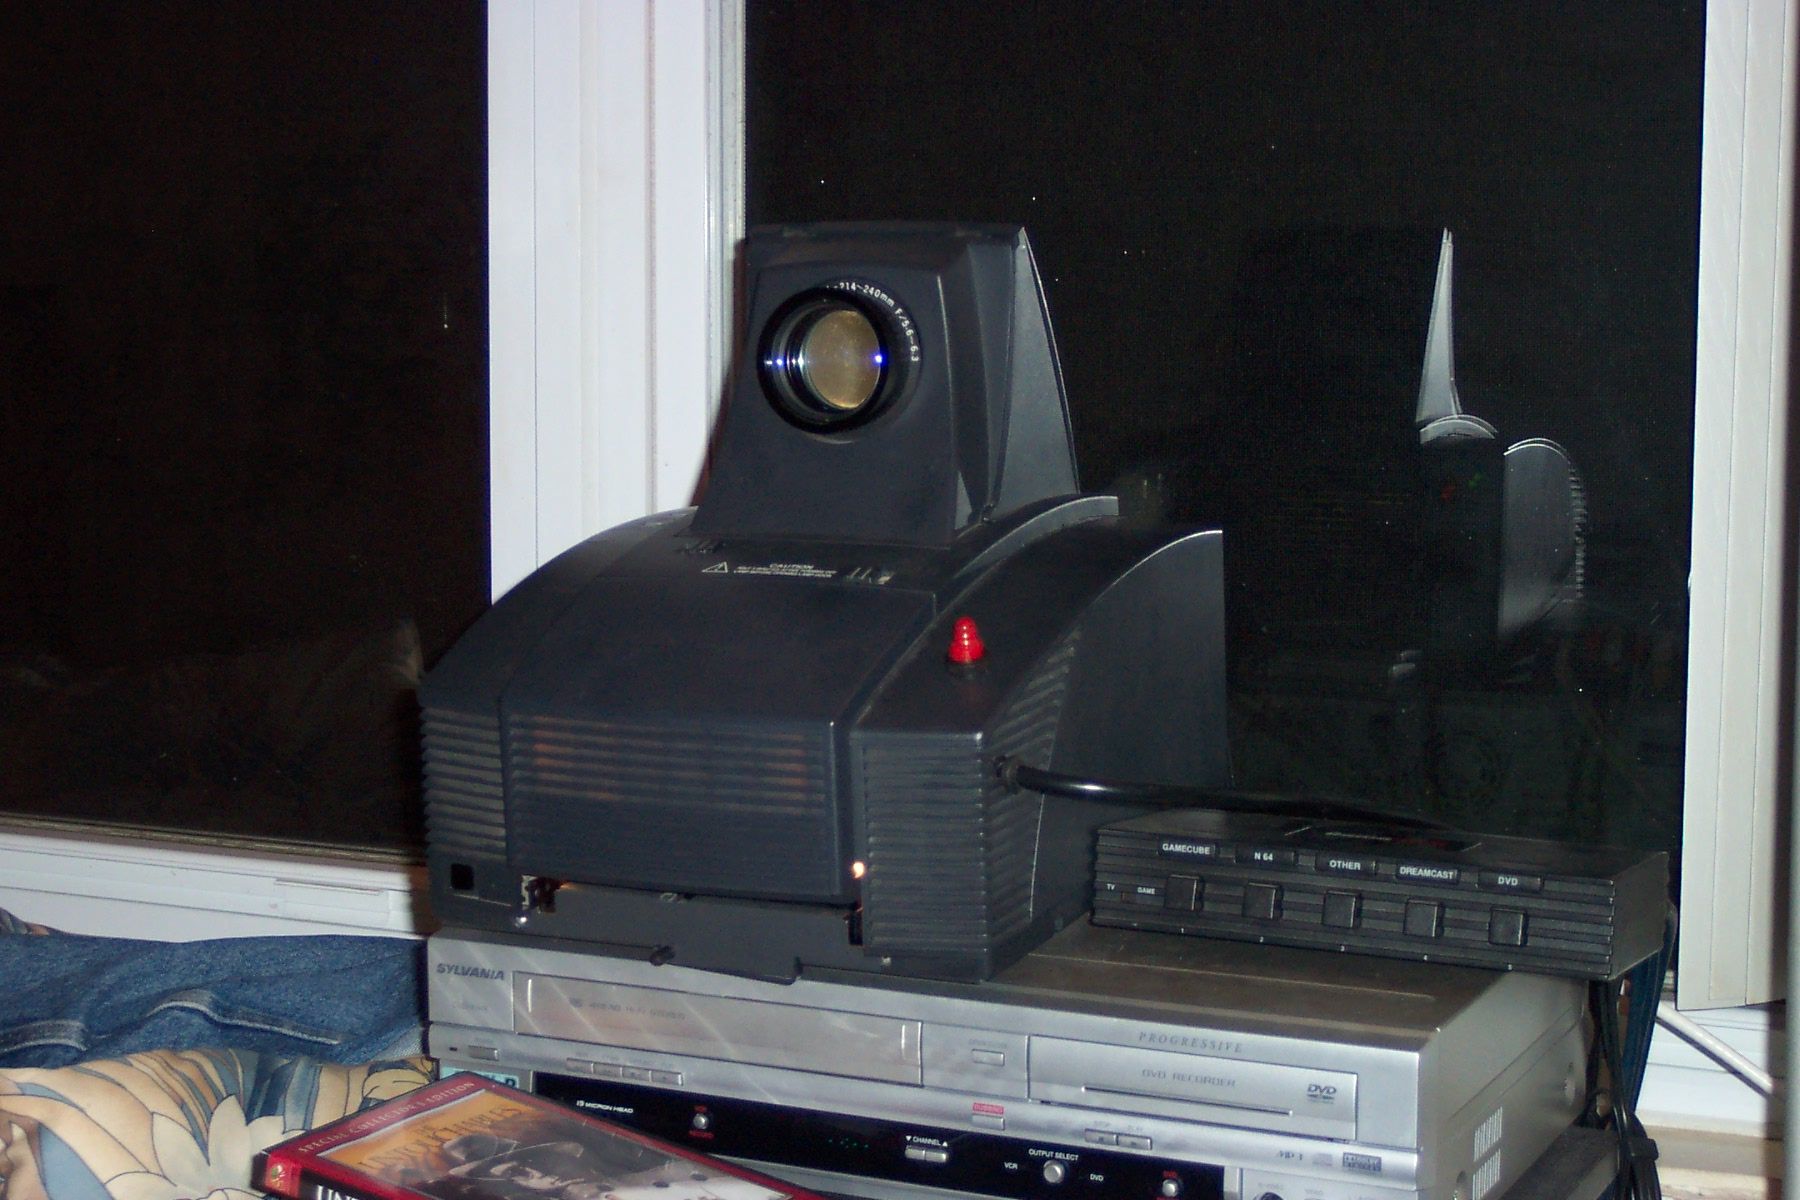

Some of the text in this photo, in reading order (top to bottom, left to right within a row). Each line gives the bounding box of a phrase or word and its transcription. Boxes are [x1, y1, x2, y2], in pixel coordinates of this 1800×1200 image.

[1162, 843, 1211, 855] GAMECUBE
[1254, 852, 1274, 862] N 64
[1329, 859, 1361, 871] OTHER
[1400, 866, 1454, 880] DREAMCAST
[1106, 883, 1115, 891] TV
[1498, 876, 1518, 886] DVD
[1137, 886, 1156, 895] GAME
[436, 963, 505, 981] SYLVANIA
[1138, 1031, 1243, 1054] PROGRESSIVE
[1142, 1068, 1236, 1088] DVD RECORDER
[1307, 1083, 1337, 1095] DVD
[585, 1102, 612, 1111] MICRON
[613, 1106, 634, 1114] HEAD
[298, 1131, 349, 1153] SPECIAL
[424, 1081, 475, 1103] EDITION
[912, 1135, 942, 1146] CHANNEL
[1028, 1148, 1079, 1162] OUTPUT SELECT
[1004, 1161, 1018, 1171] VCR
[1090, 1173, 1104, 1182] DVD
